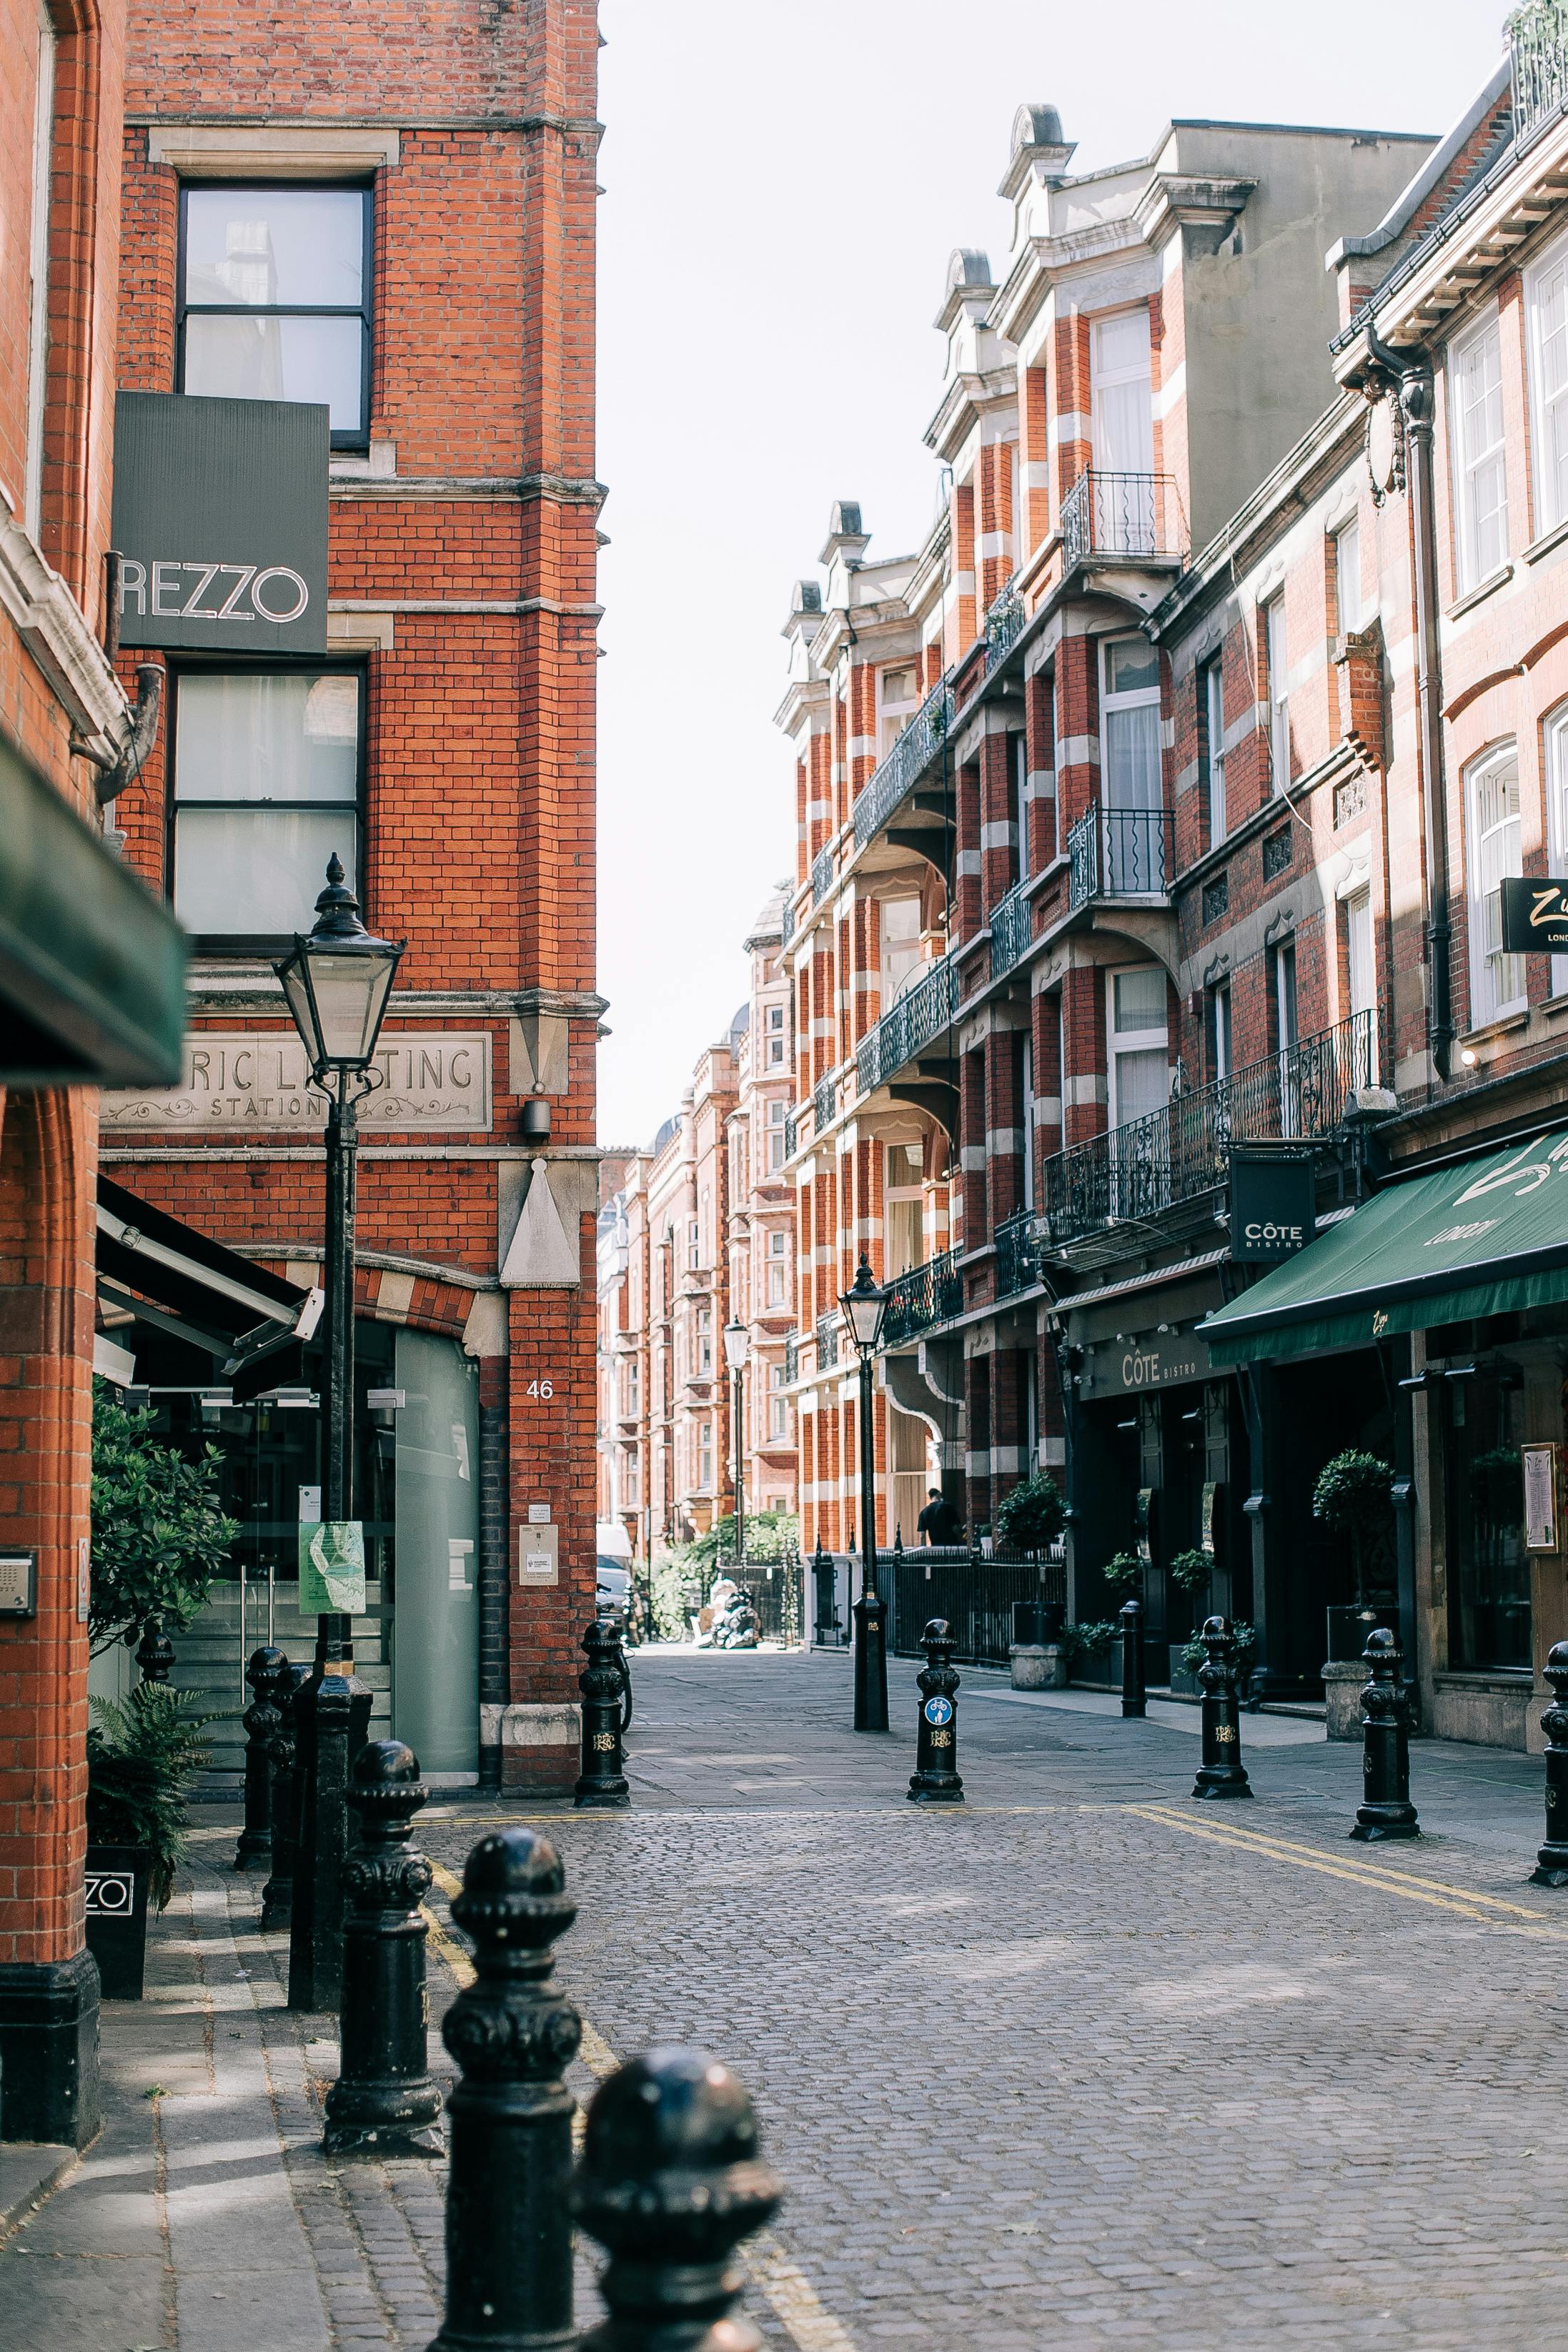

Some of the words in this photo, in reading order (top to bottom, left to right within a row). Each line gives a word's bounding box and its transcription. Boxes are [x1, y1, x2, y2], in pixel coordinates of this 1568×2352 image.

[276, 1049, 472, 1091] LITING
[210, 1097, 321, 1116] STATION
[1245, 1222, 1303, 1240] CÔTE
[1122, 1349, 1160, 1386] CÔTE
[1163, 1362, 1196, 1379] BISTRO
[526, 1380, 553, 1399] 46
